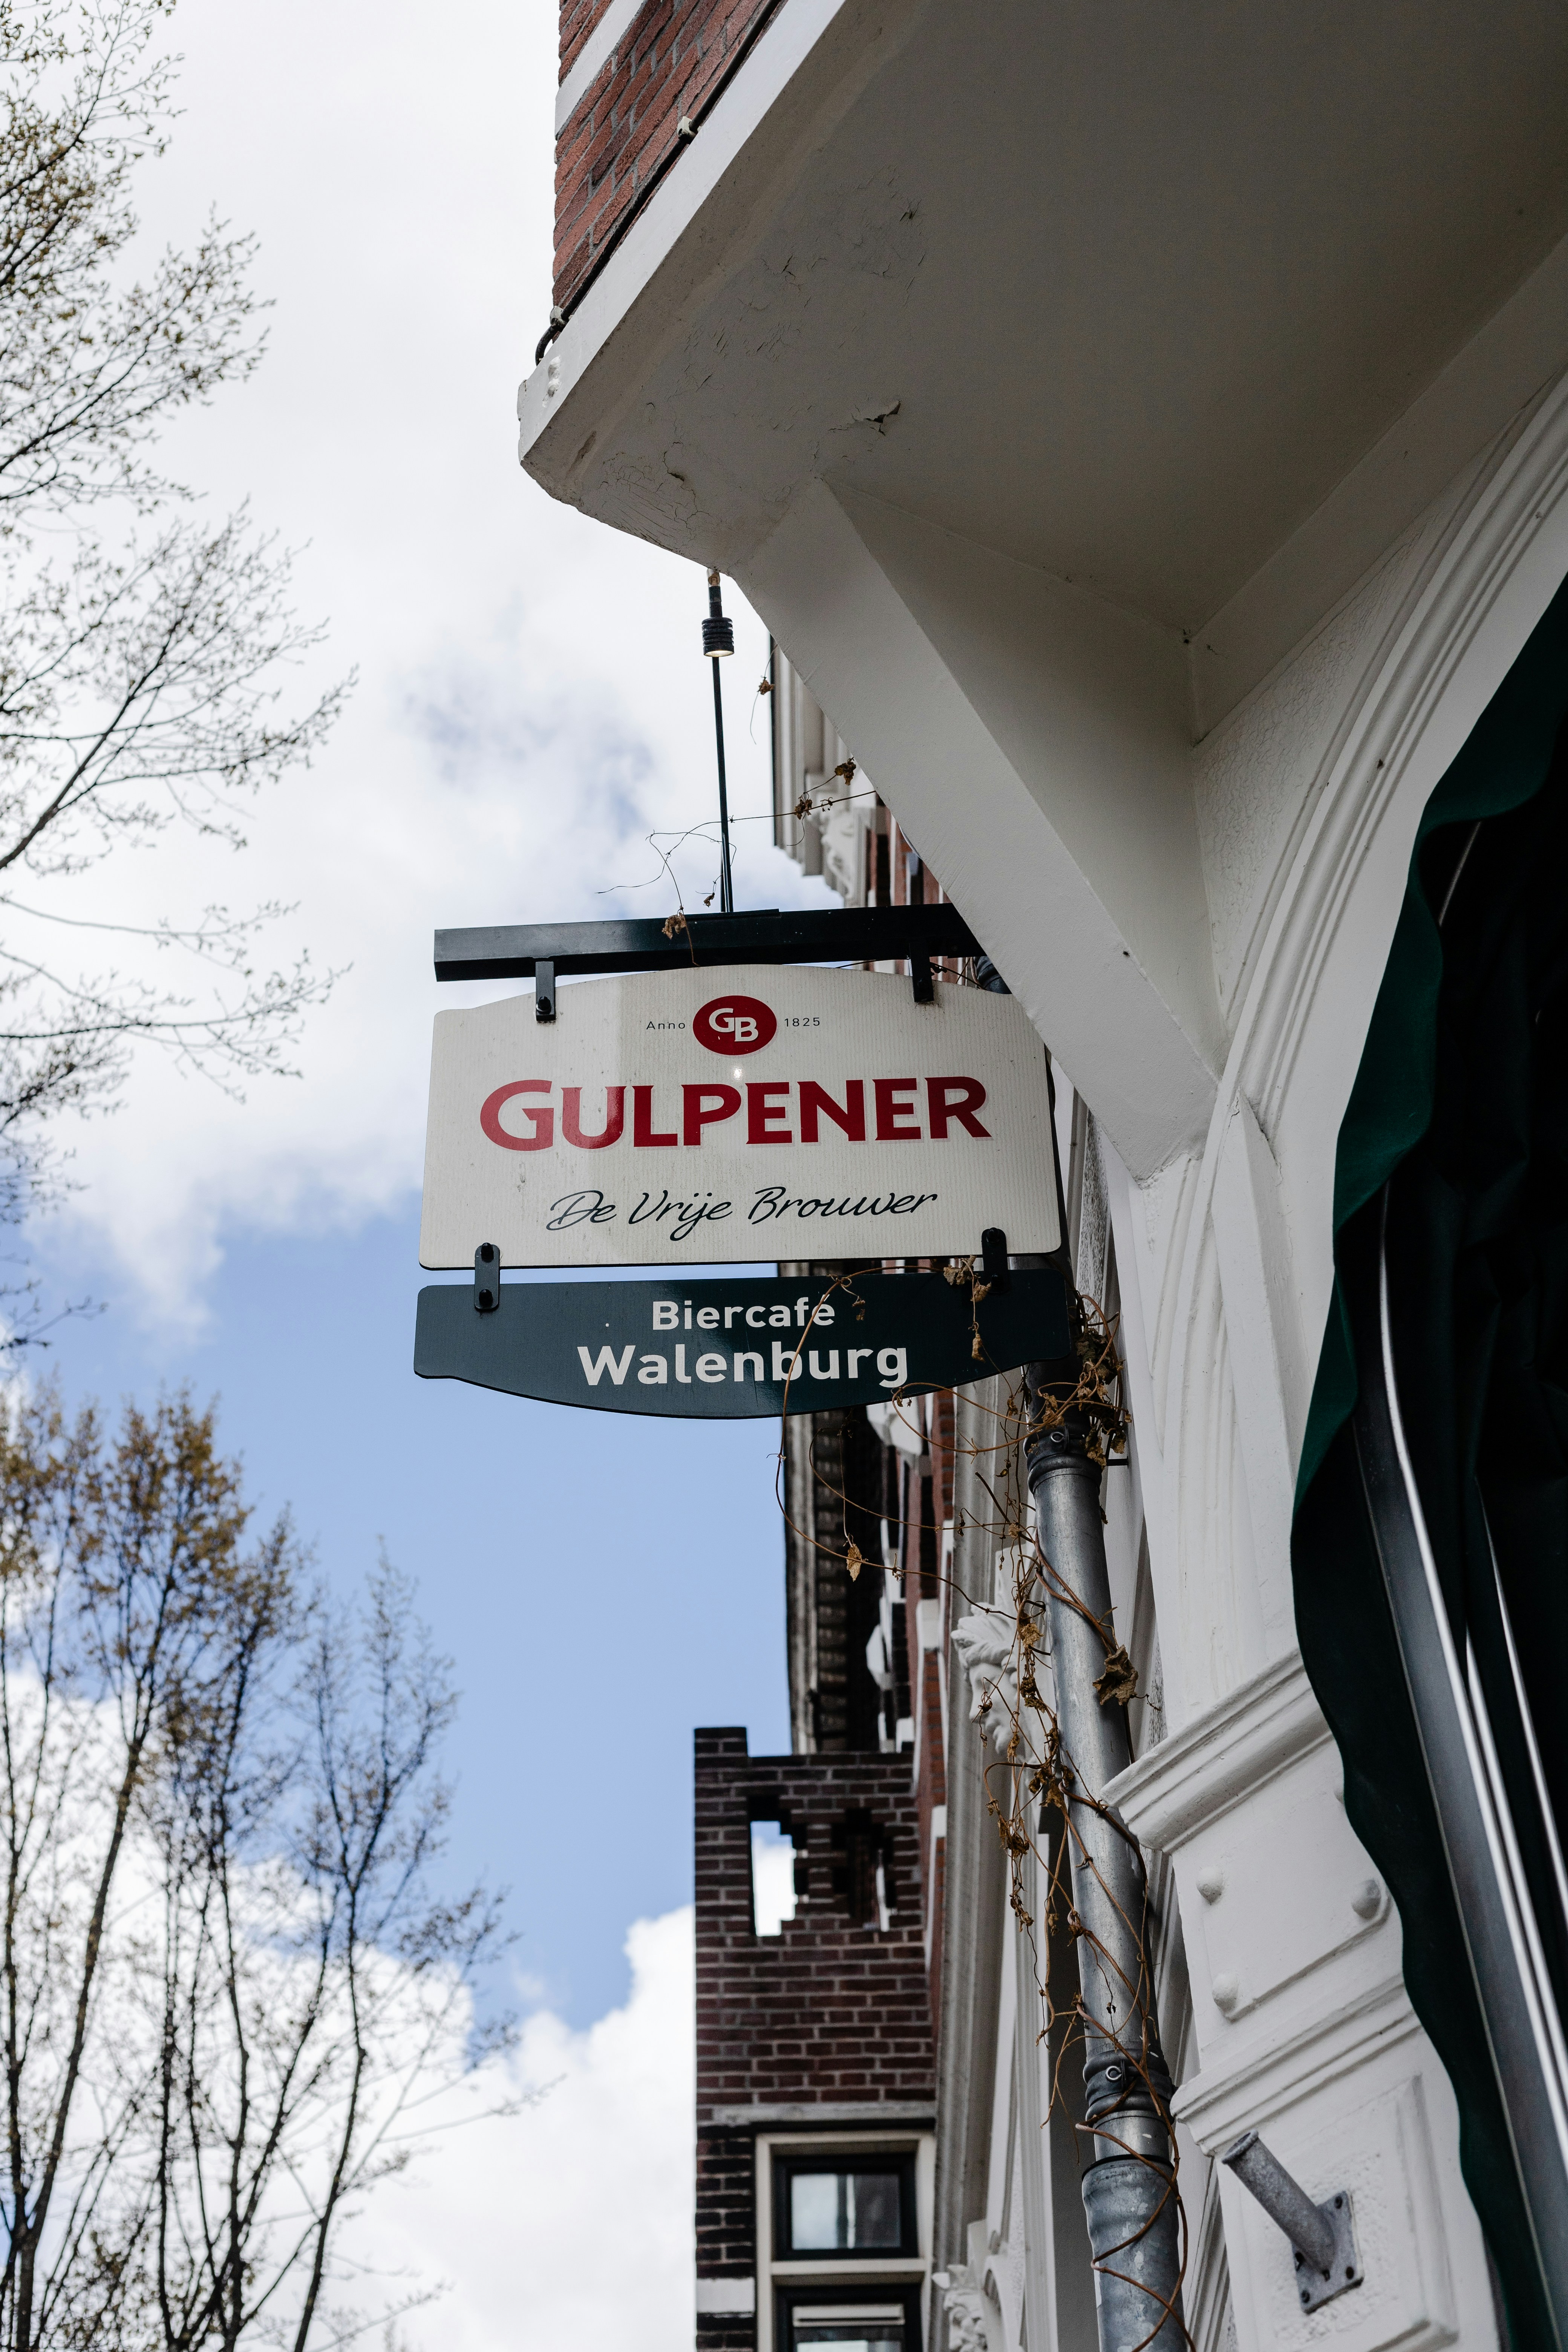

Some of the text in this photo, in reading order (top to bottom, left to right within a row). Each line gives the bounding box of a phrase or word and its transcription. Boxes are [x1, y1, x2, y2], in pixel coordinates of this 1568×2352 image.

[646, 1008, 820, 1042] Anno GB 1825
[479, 1076, 992, 1151] GULPENER
[546, 1186, 938, 1242] De Vrije Brouwer
[652, 1294, 835, 1331] Biercafé
[577, 1341, 908, 1388] Walenburg
